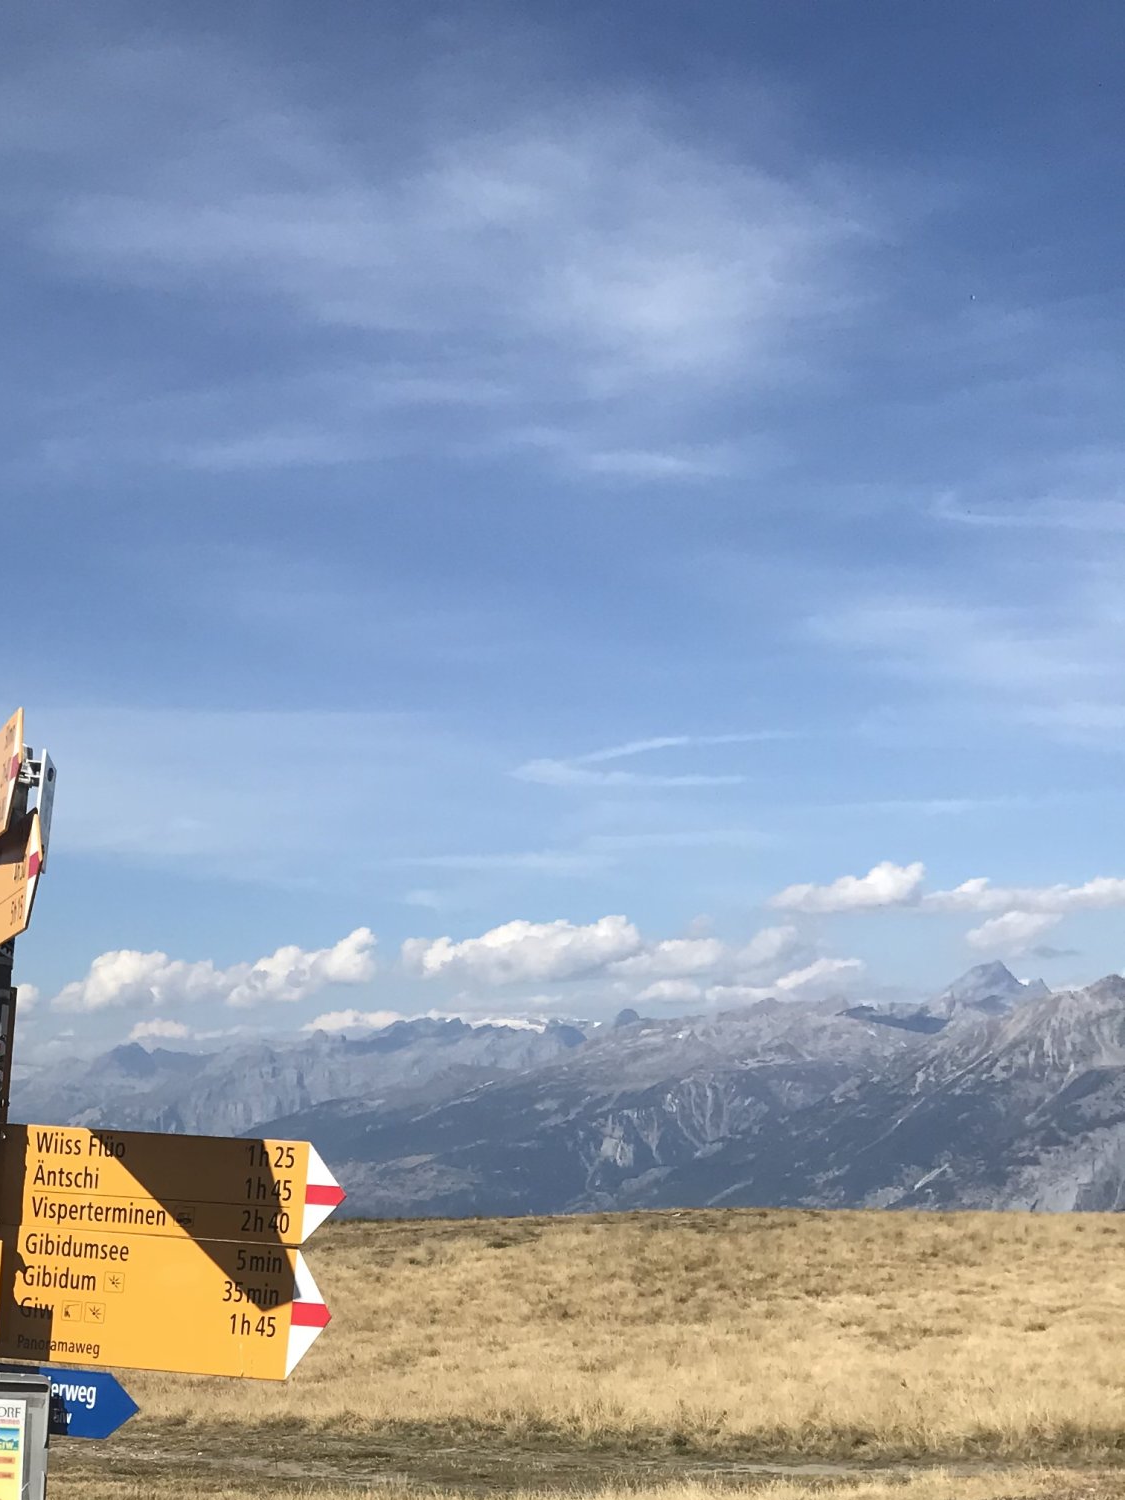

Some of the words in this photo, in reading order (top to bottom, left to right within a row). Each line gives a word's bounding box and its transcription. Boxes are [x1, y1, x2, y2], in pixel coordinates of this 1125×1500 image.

[36, 1132, 82, 1156] Wiiss
[88, 1133, 126, 1159] Flüo
[32, 1160, 99, 1189] Äntschi
[31, 1196, 166, 1227] Visperterminen
[25, 1232, 129, 1262] Gibidumsee
[23, 1265, 97, 1292] Gibidum
[19, 1296, 54, 1320] Giw
[17, 1334, 100, 1359] Panoramaweg
